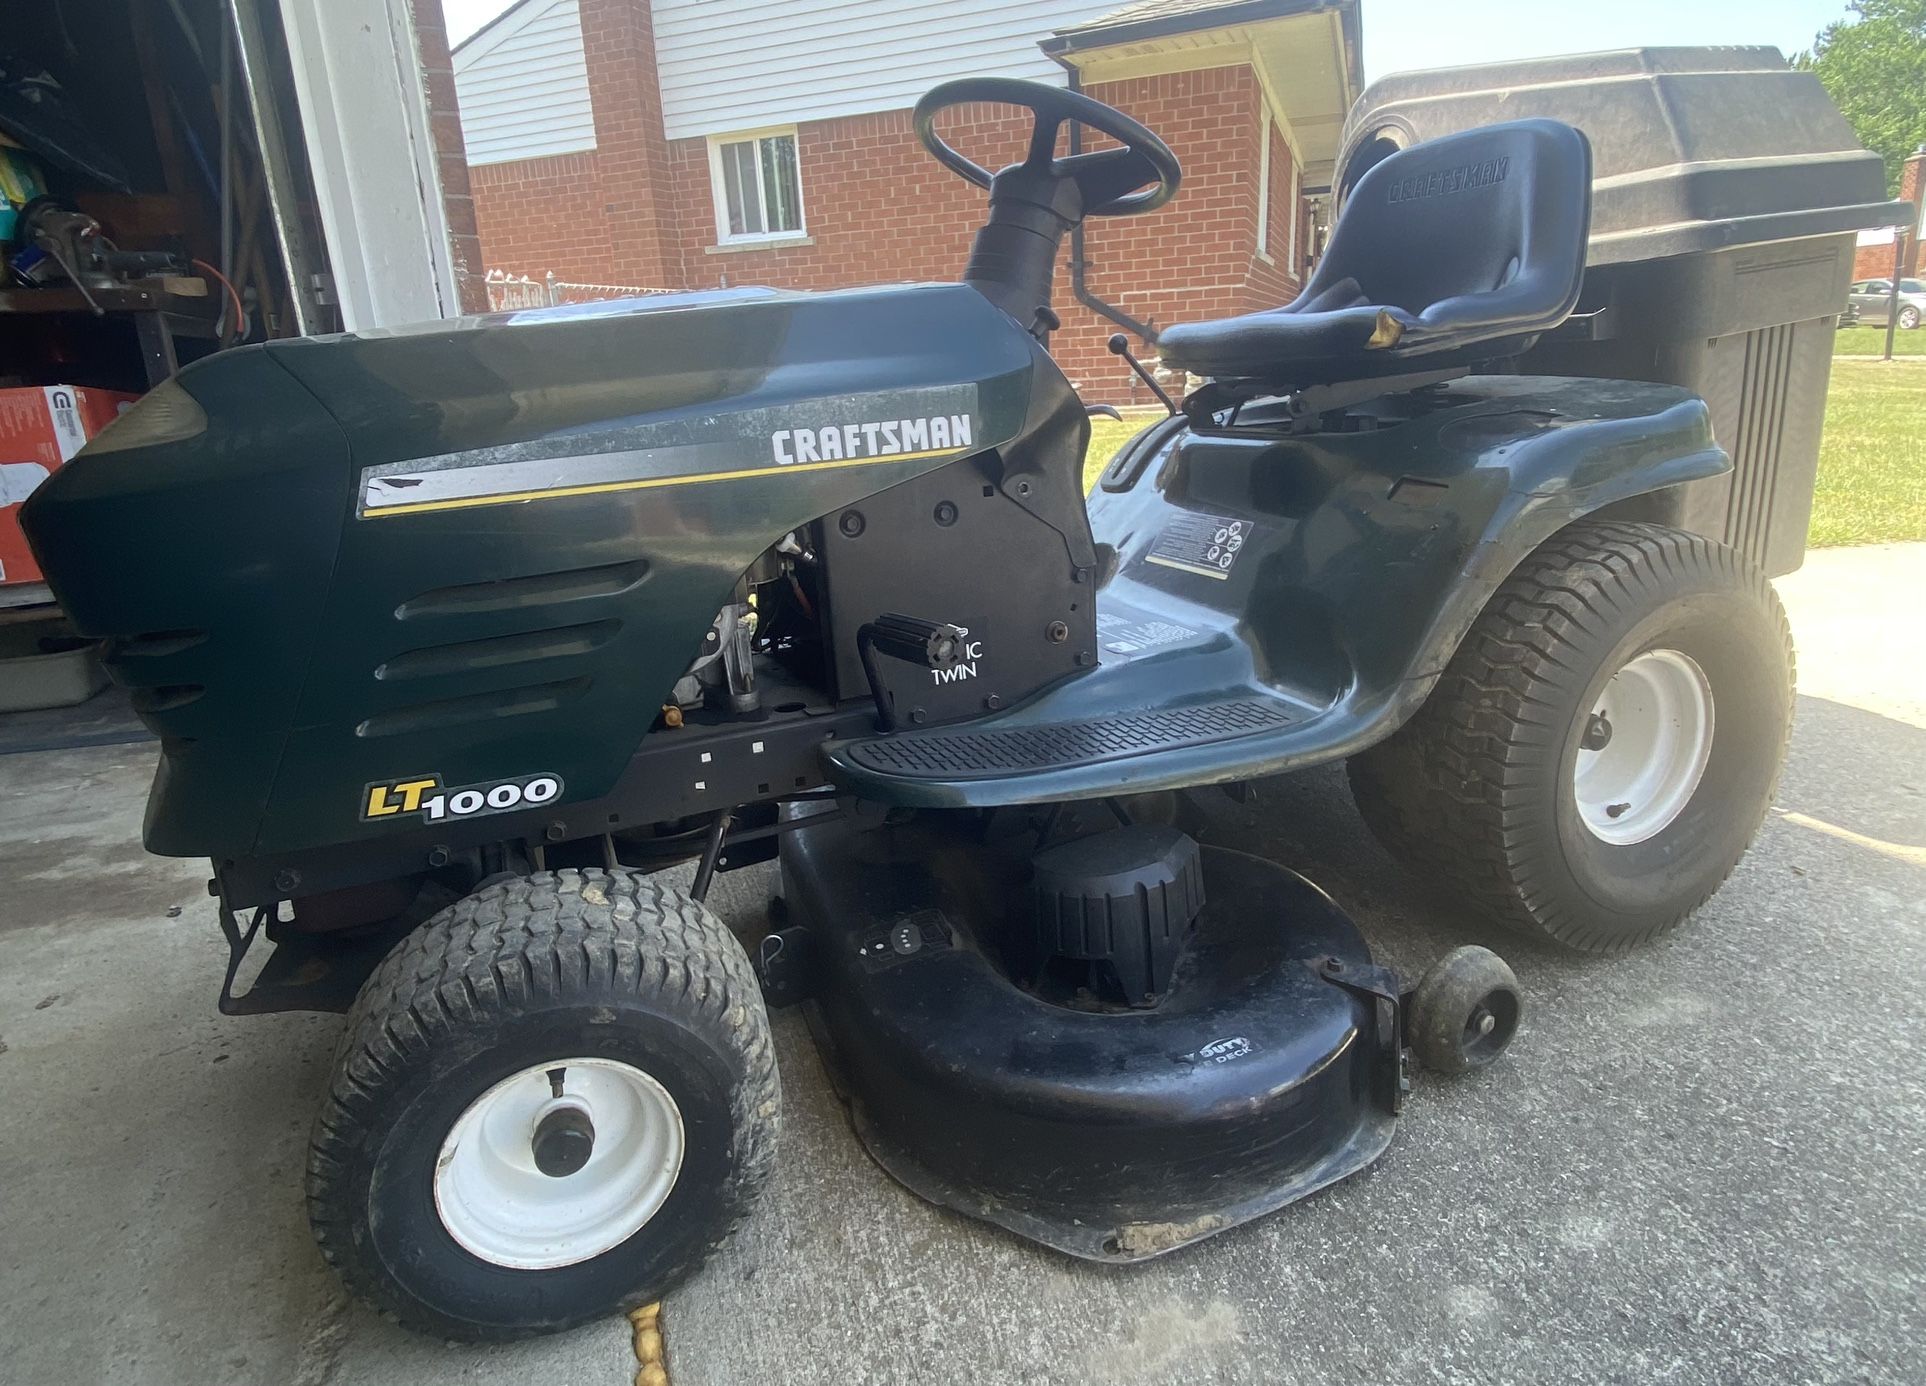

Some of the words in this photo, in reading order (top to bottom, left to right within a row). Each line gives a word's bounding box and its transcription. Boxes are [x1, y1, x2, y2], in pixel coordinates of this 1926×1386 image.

[771, 414, 972, 465] CRAFTSMAN
[931, 661, 977, 686] TWIN
[1215, 1046, 1253, 1064] DECK
